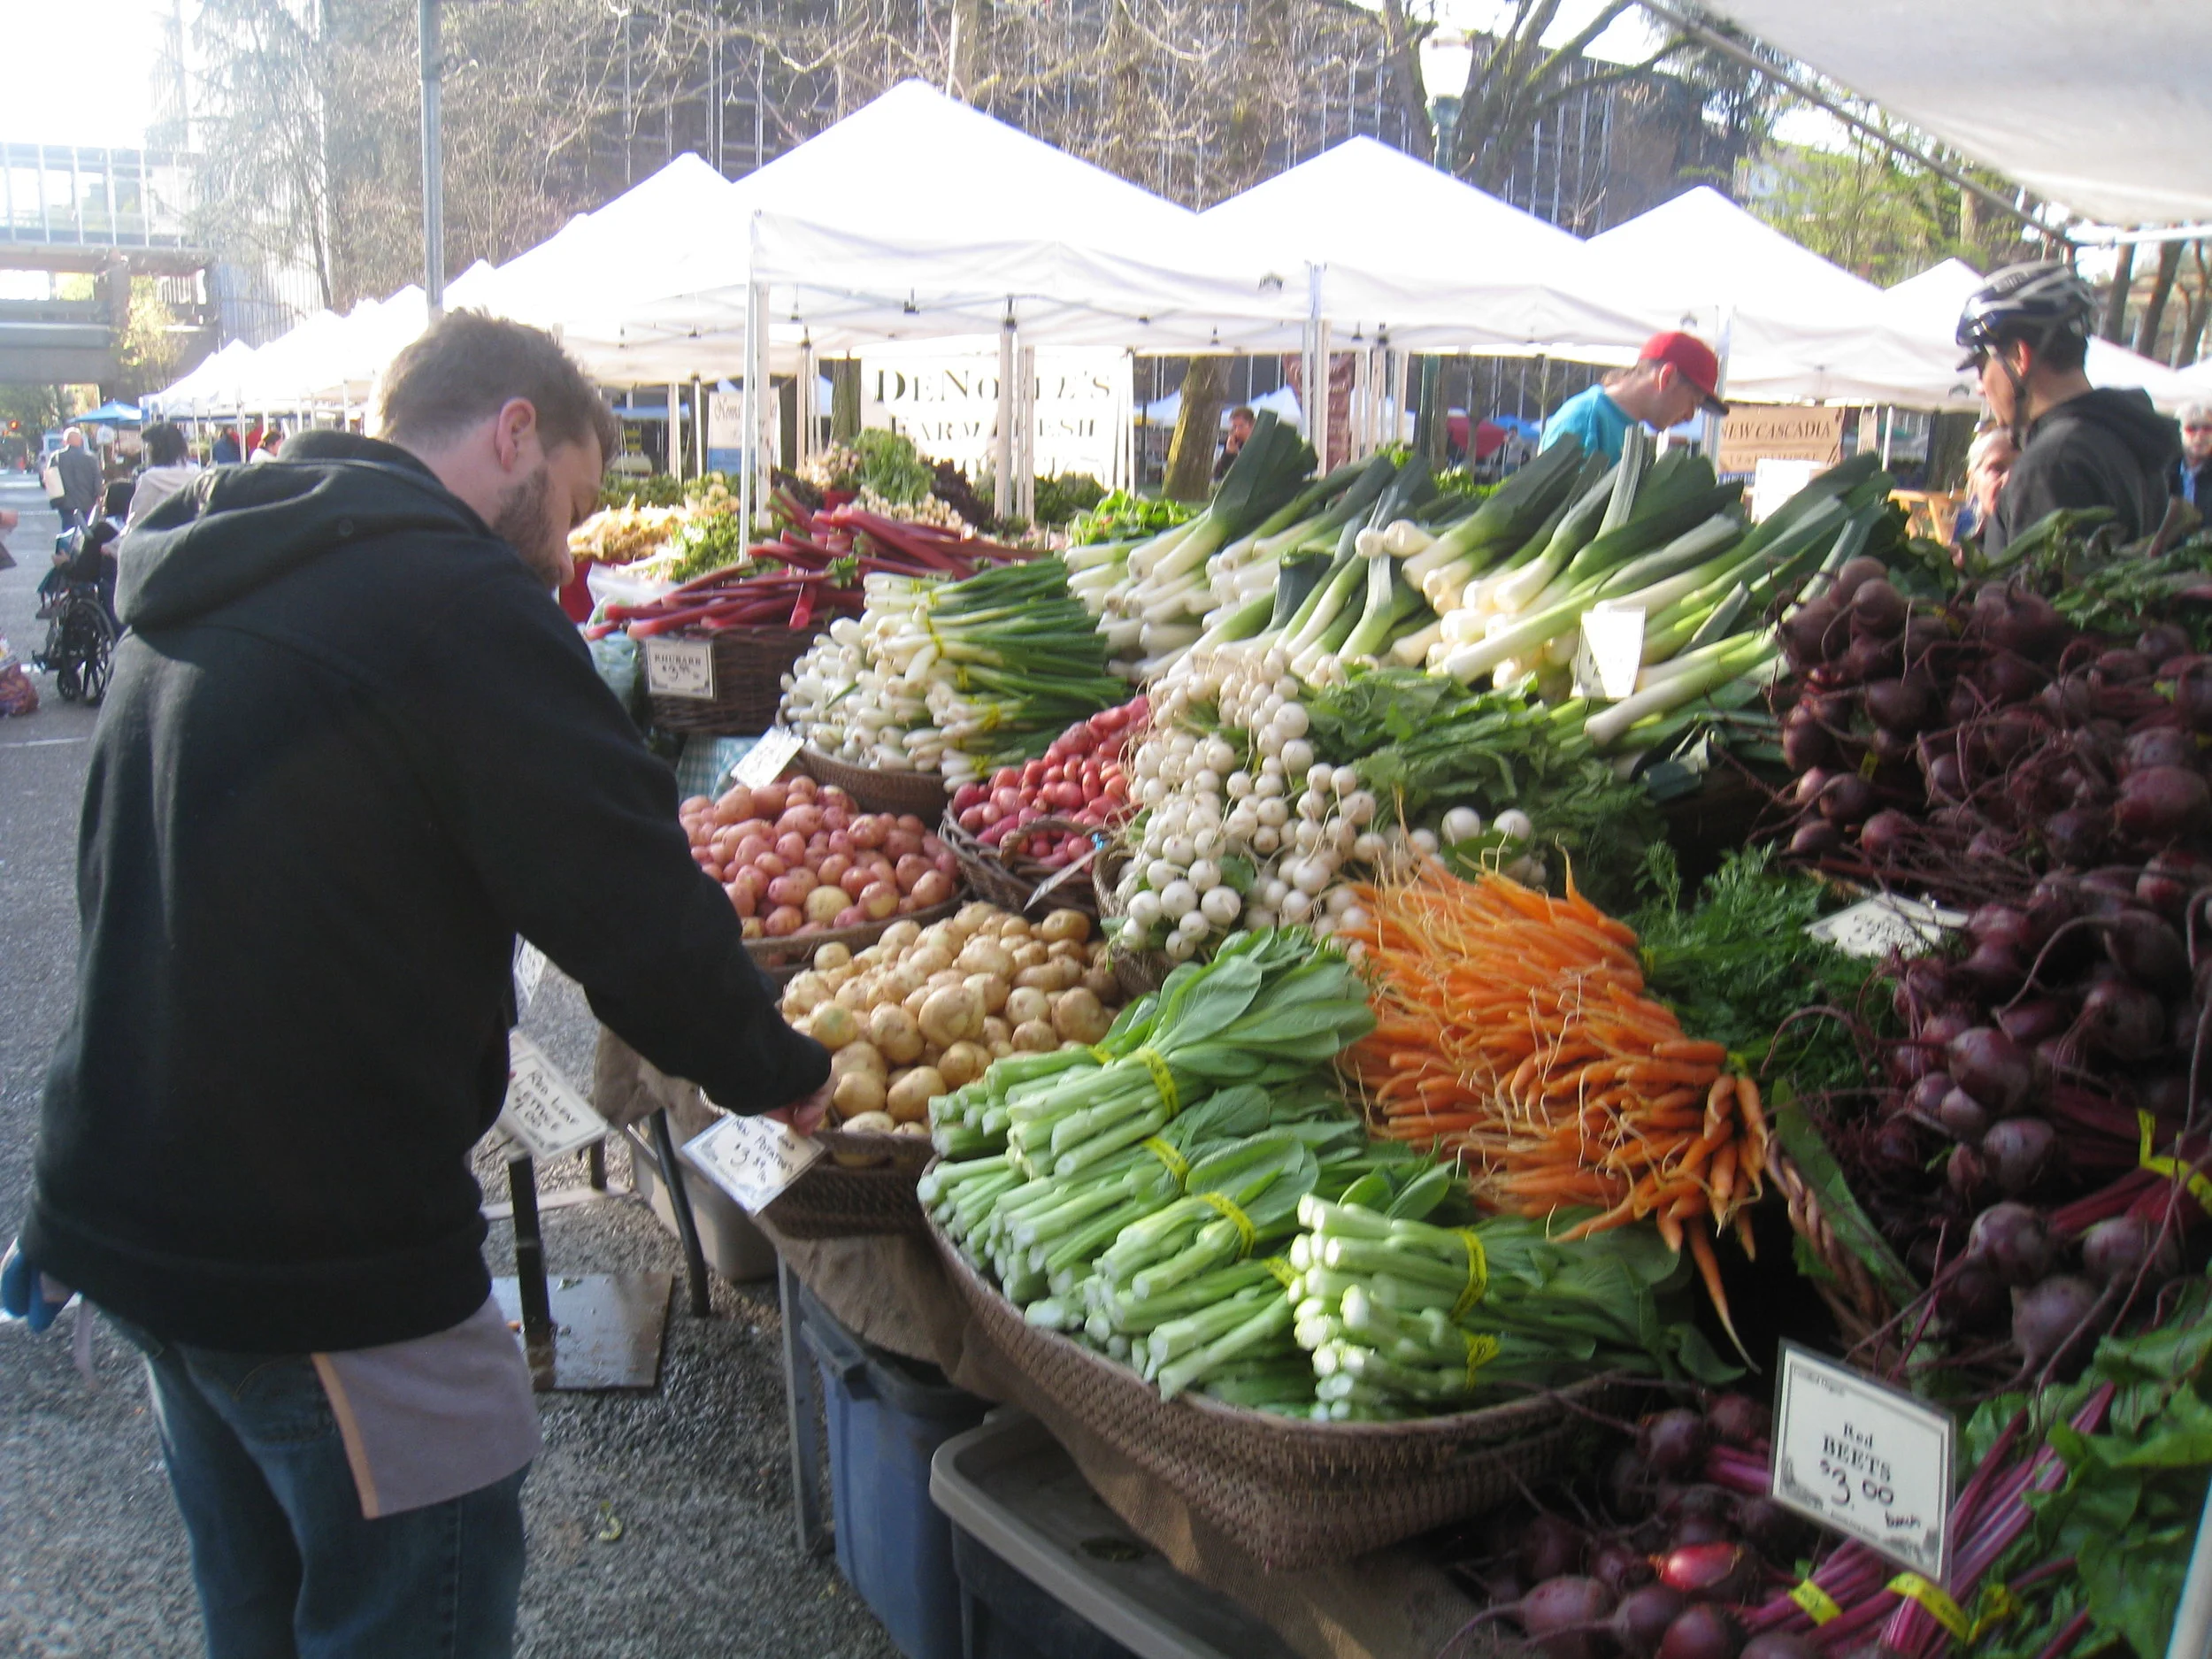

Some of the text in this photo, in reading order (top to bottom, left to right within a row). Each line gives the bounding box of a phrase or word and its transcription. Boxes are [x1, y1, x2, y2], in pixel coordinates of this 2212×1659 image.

[873, 369, 1110, 404] DENOLE'S
[990, 416, 1094, 438] ESH
[1843, 1421, 1873, 1449] Red
[1823, 1434, 1892, 1483] BEETS
